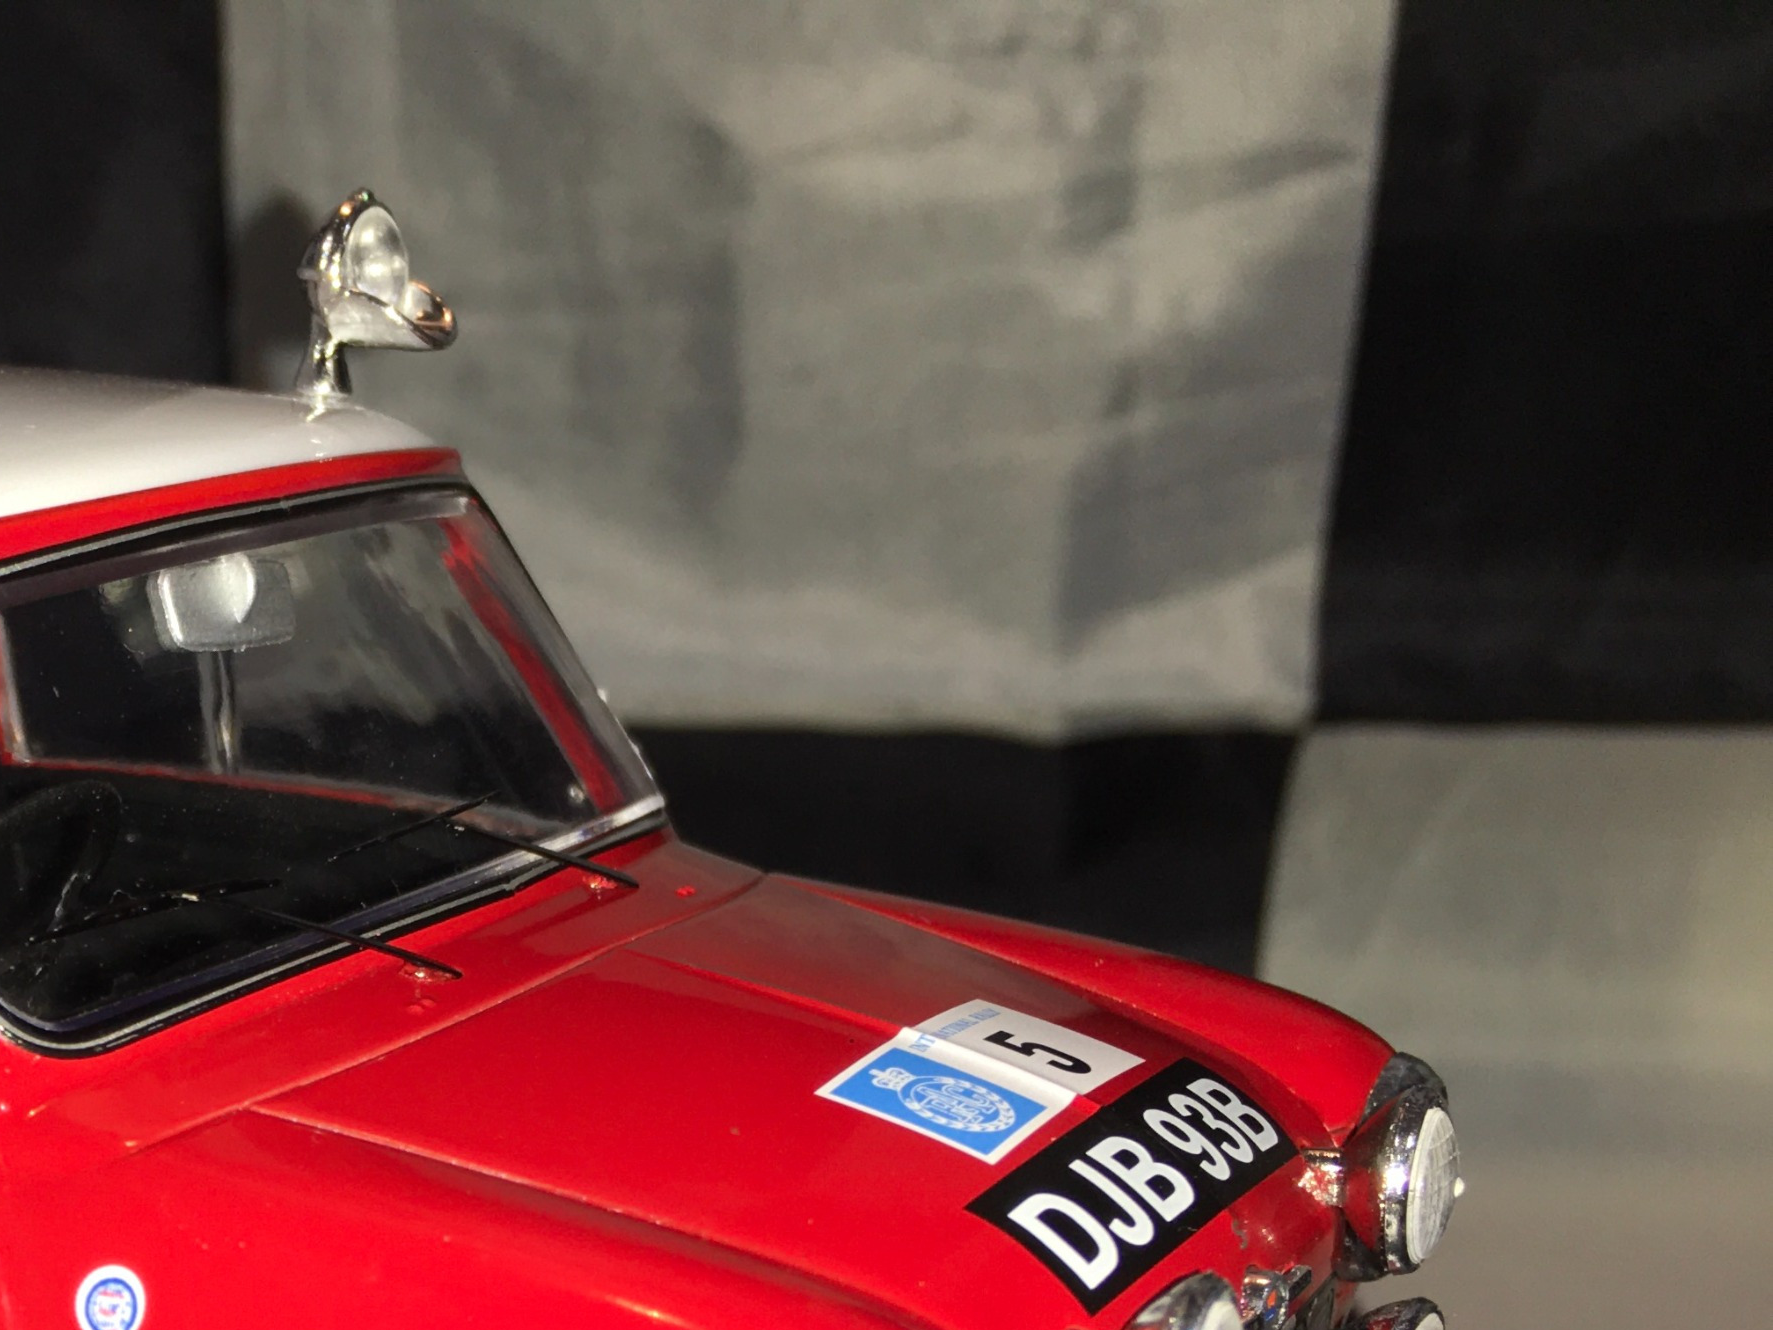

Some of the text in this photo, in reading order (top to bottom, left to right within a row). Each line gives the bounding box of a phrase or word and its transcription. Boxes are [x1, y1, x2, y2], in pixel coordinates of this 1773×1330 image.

[983, 1030, 1092, 1075] 5
[1007, 1078, 1279, 1290] DJB 93B
